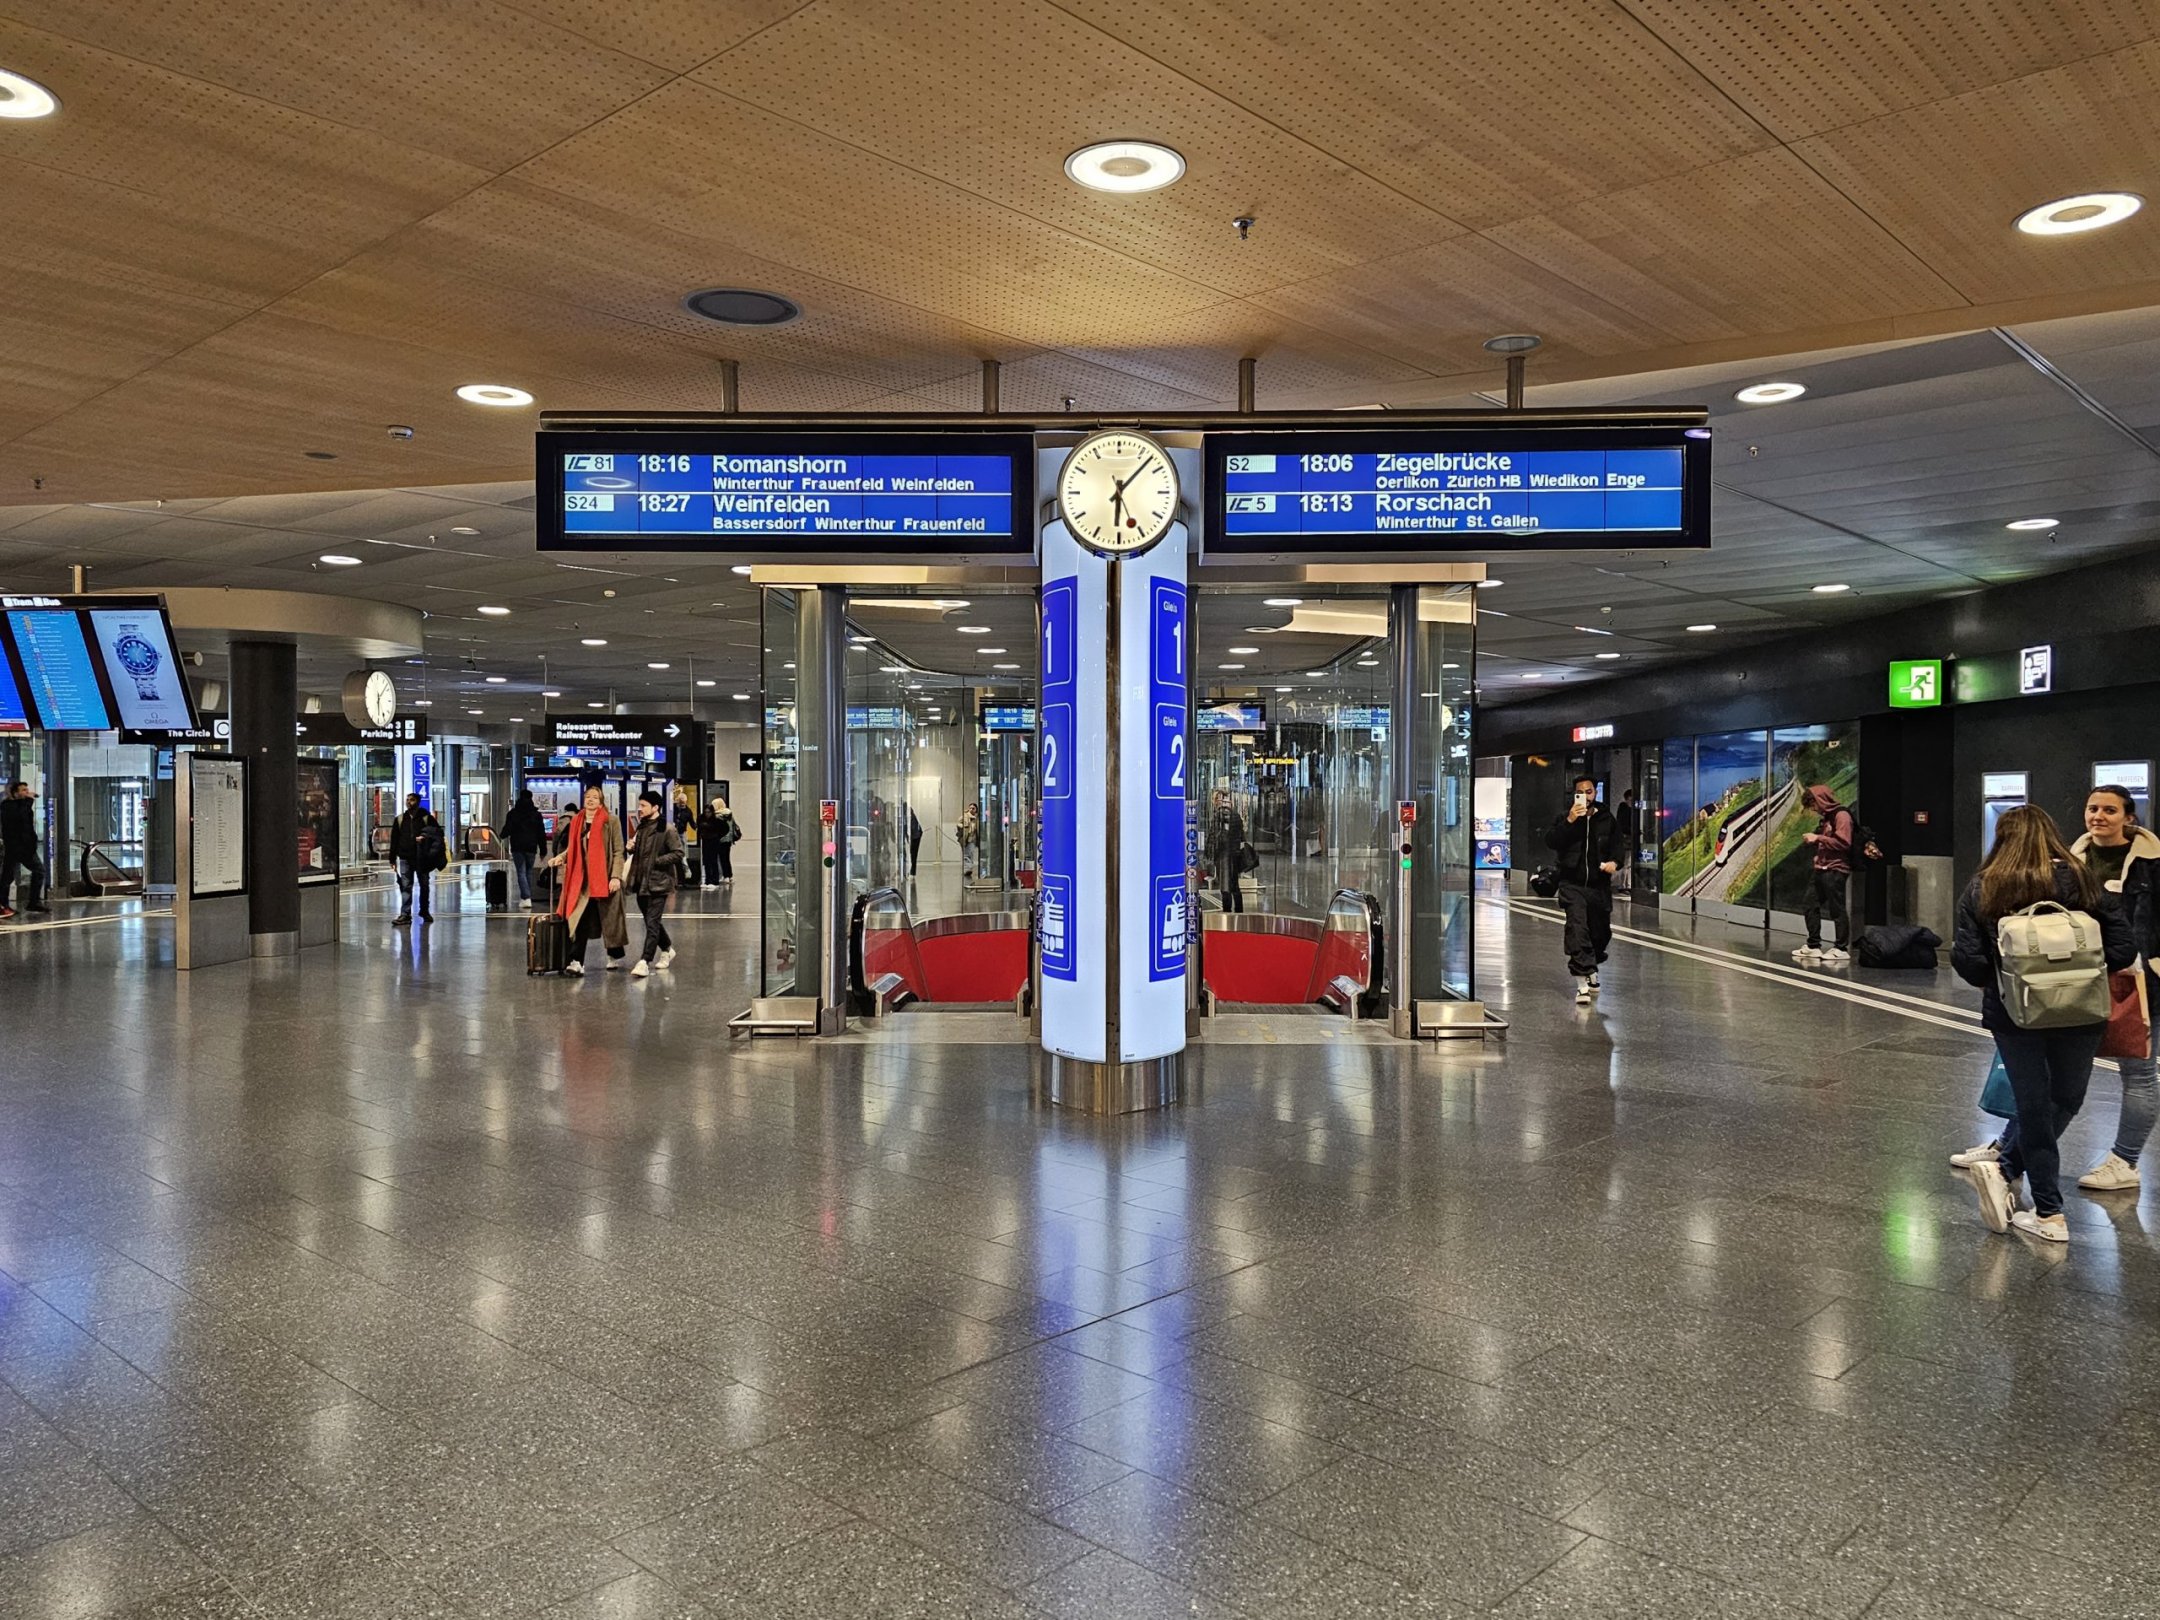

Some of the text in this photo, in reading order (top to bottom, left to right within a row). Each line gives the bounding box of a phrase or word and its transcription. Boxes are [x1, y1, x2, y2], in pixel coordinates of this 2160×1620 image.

[567, 455, 847, 474] IC 81 18:16 Romanshorn
[1229, 453, 1512, 477] S2 18:06 Ziegelbrücke
[713, 477, 974, 491] Winterthur Frauenfeld Weinfelden
[1376, 473, 1646, 489] Oerlikon Zürich HB Wiedikon Enge
[567, 494, 830, 514] S24 18:27 Weinfelden
[1229, 493, 1491, 512] IC 5 18:13 Rorschach
[713, 516, 985, 532] Bassersdorf Winterthur Frauenfeld
[1376, 514, 1539, 530] Winterthur St. Gallen
[1163, 600, 1178, 614] Gleis
[1045, 621, 1052, 674] 1
[1173, 621, 1182, 675] 1
[1163, 716, 1177, 728] Gleis
[185, 730, 211, 738] Circle
[361, 729, 393, 739] Parking
[556, 731, 643, 740] Railway Travelcenter
[419, 761, 427, 774] 3
[1044, 734, 1057, 786] 2
[1170, 734, 1184, 787] 2
[419, 785, 426, 797] 4
